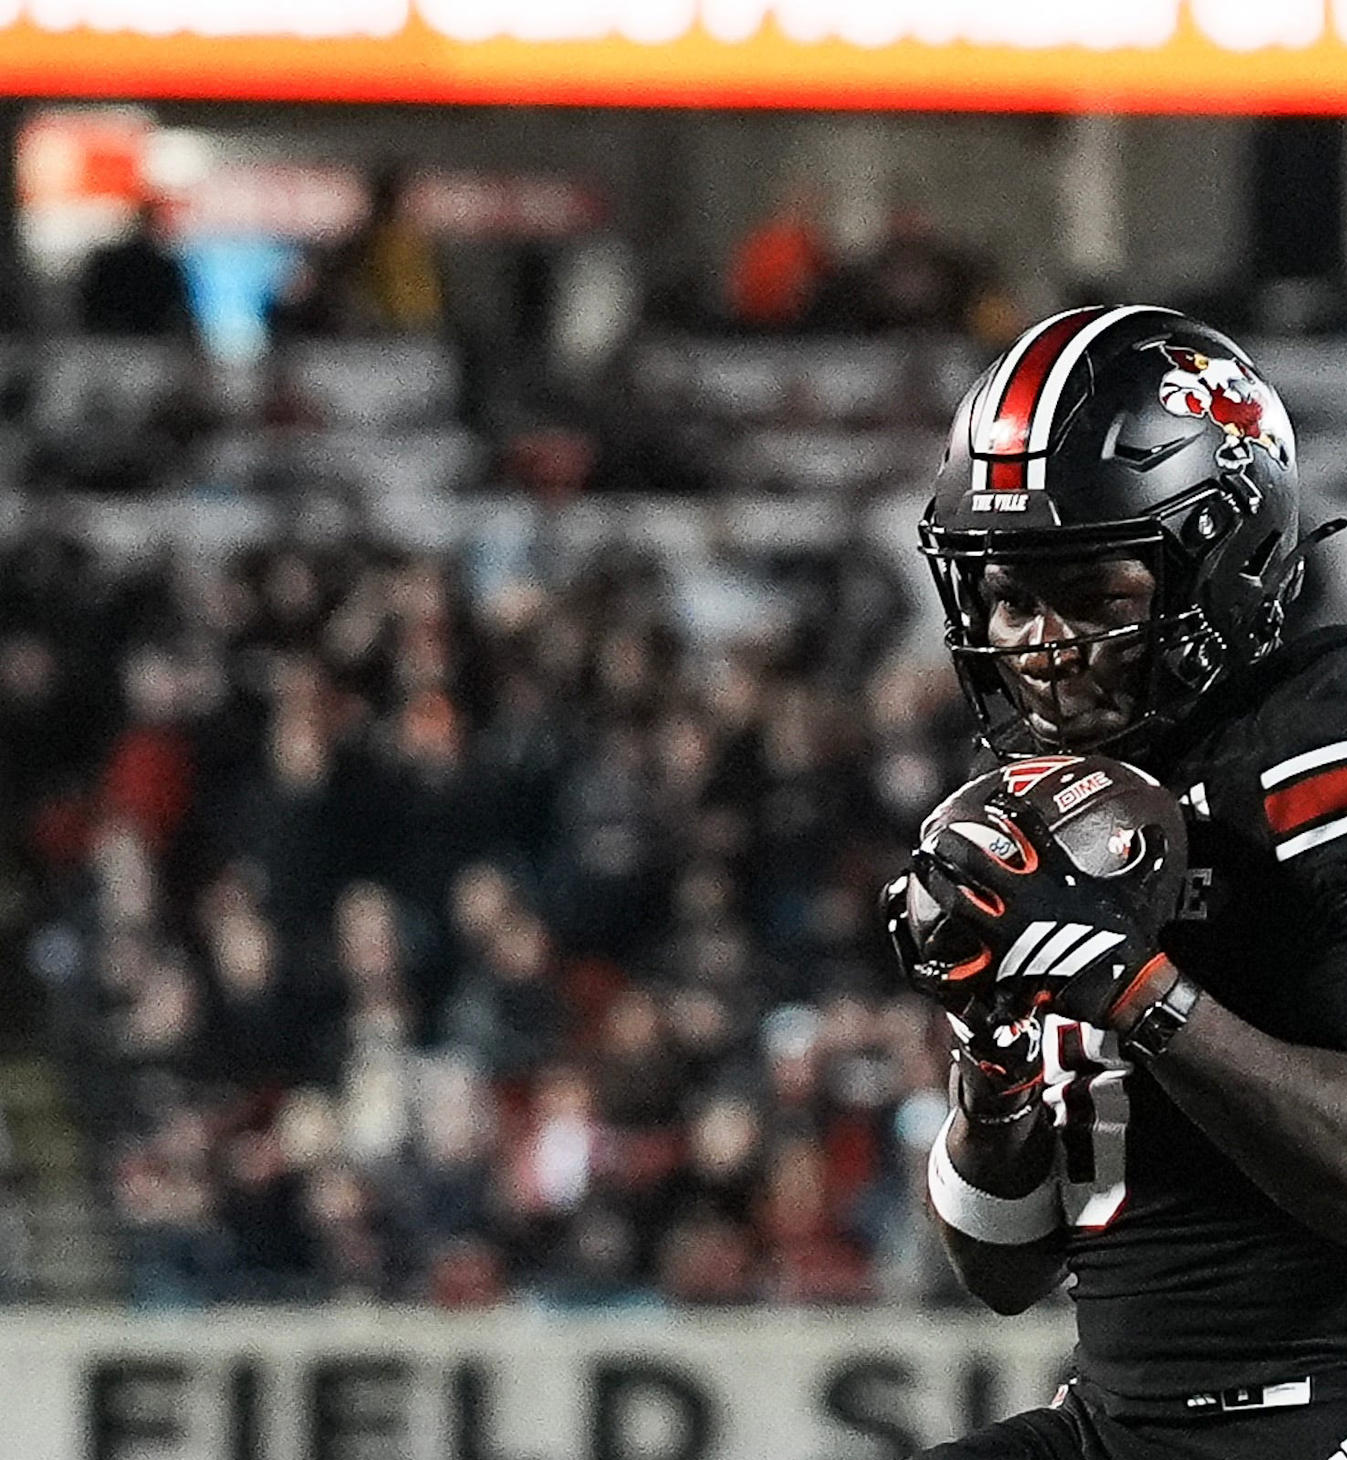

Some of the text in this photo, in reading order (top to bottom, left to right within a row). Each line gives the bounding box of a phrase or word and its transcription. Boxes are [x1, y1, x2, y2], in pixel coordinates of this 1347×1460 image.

[972, 494, 1029, 511] THE VILLE
[1053, 771, 1113, 814] DIME
